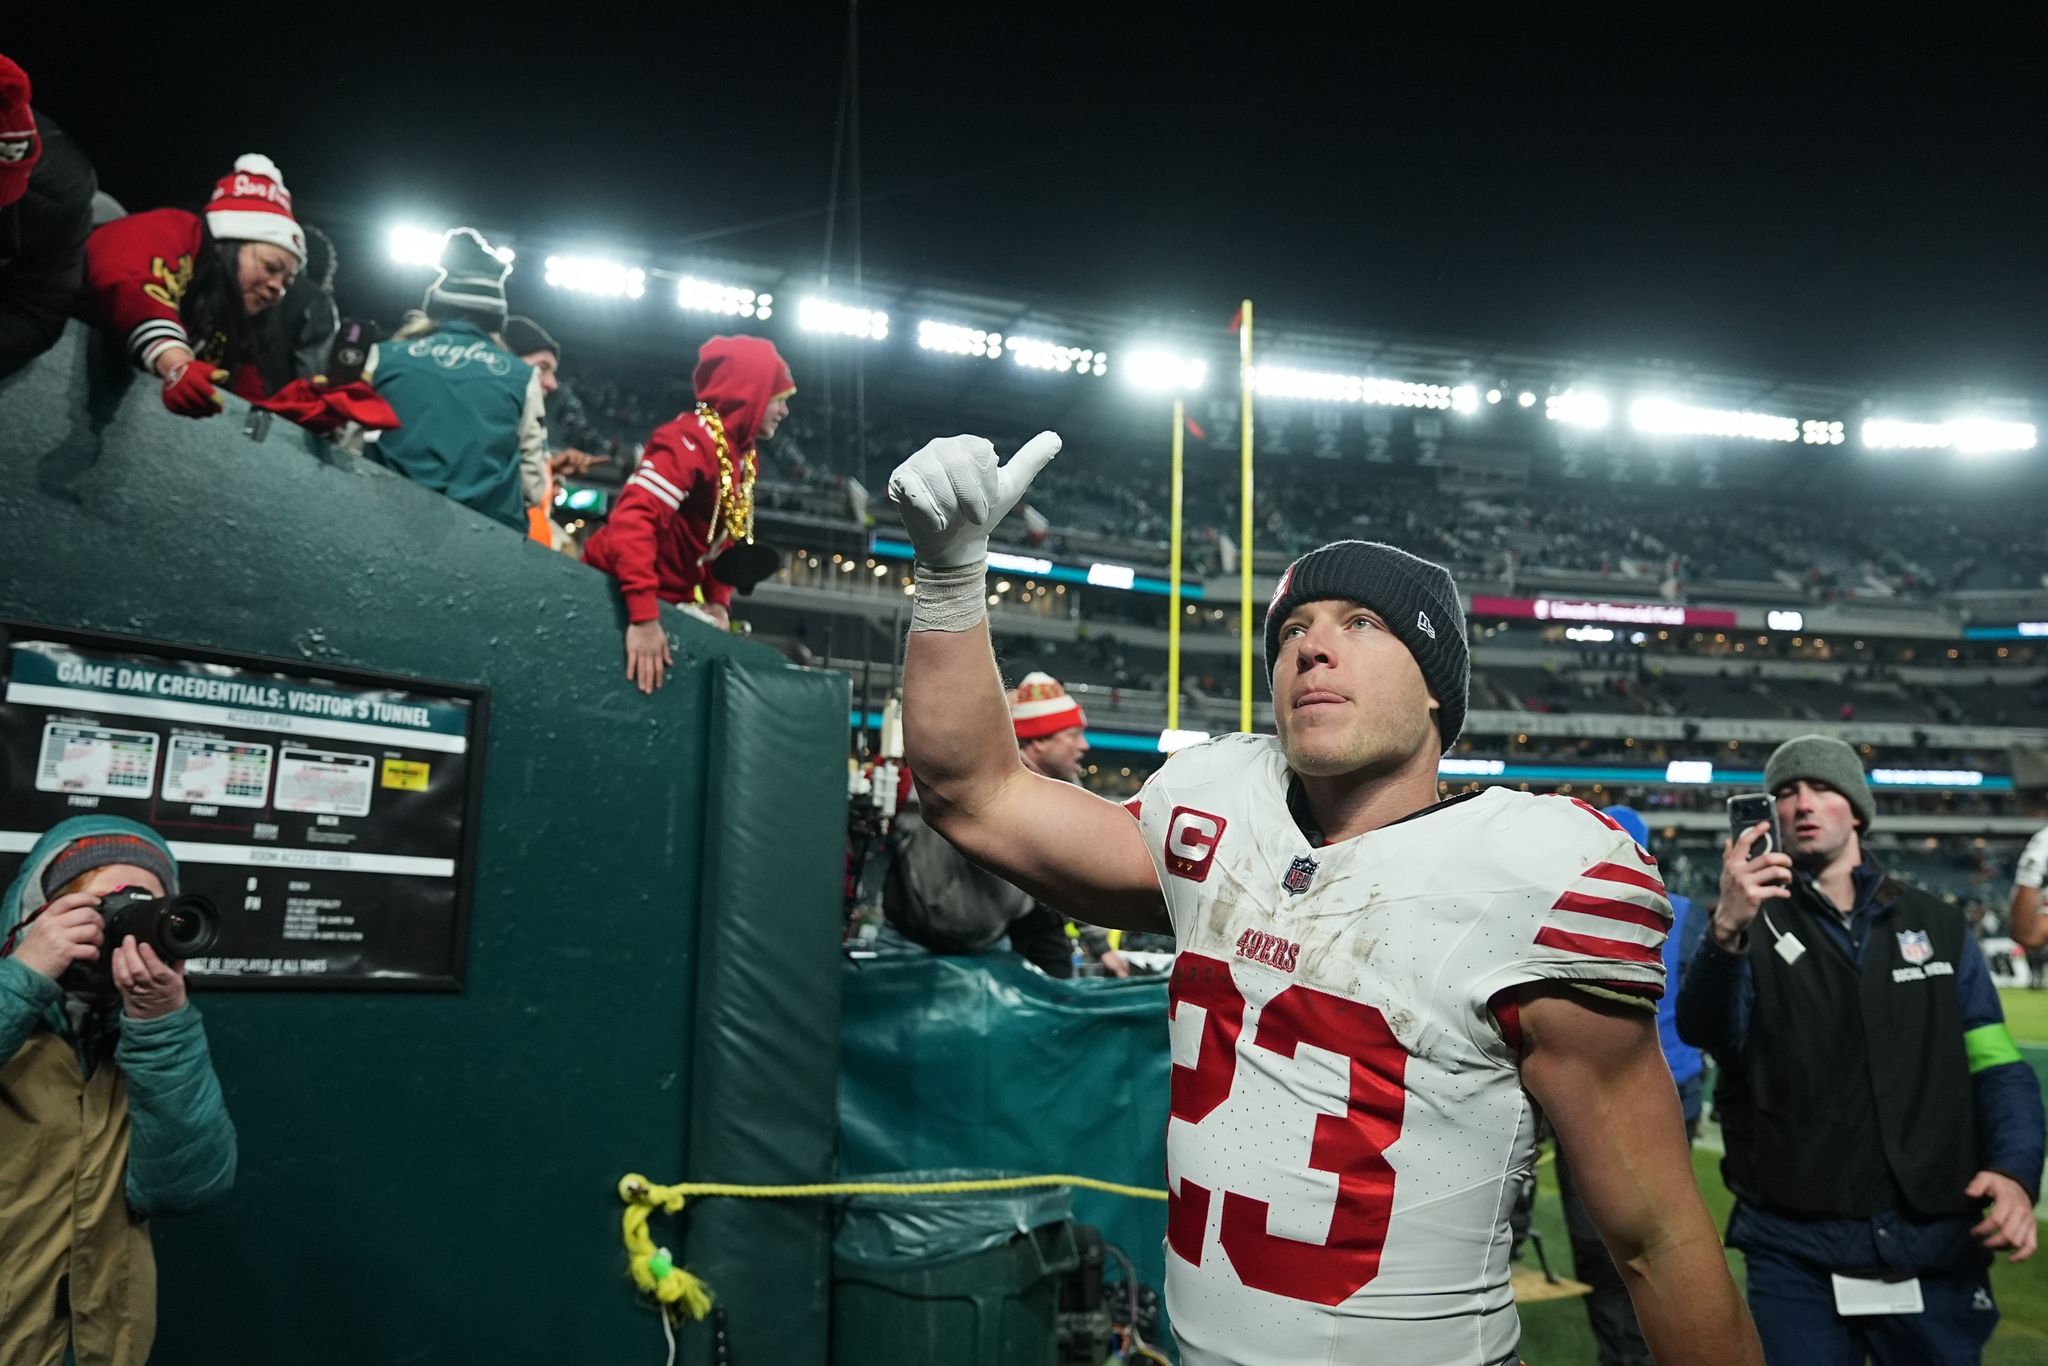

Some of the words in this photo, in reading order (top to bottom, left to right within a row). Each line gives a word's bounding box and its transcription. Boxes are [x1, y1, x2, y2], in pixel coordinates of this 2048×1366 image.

[408, 338, 497, 368] Eagles
[56, 662, 115, 687] GAME
[115, 668, 156, 692] DAY
[157, 674, 285, 709] CREDENTIALS:
[287, 690, 369, 720] VISITOR'S
[371, 702, 431, 727] TUNNEL
[1169, 812, 1218, 862] C
[1286, 869, 1312, 890] NFL
[1236, 928, 1300, 973] 49ERS
[1166, 950, 1407, 1306] 23
